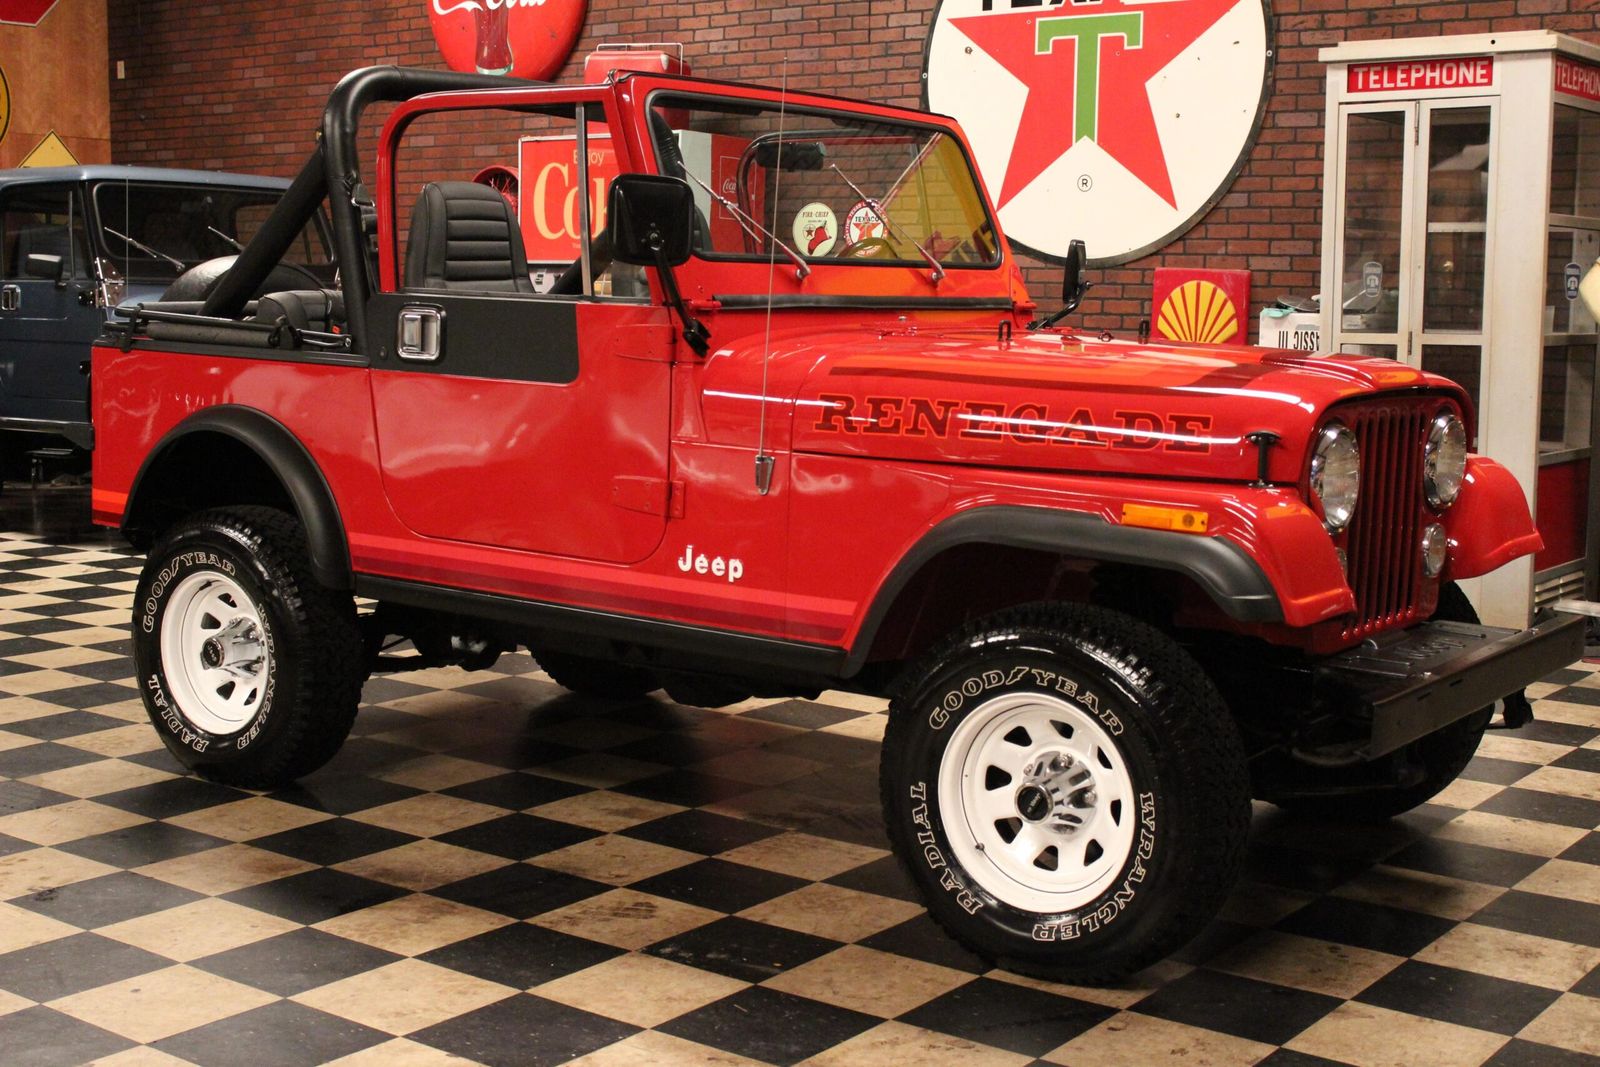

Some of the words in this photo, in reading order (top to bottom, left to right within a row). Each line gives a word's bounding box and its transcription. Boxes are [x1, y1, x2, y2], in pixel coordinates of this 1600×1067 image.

[1353, 60, 1489, 90] TELEPHONE
[813, 393, 1213, 455] RENEGADE
[677, 544, 744, 583] Jeep
[148, 674, 210, 752] RADIAL
[910, 782, 984, 915] RADIAL
[1032, 792, 1156, 941] WRANGLER
